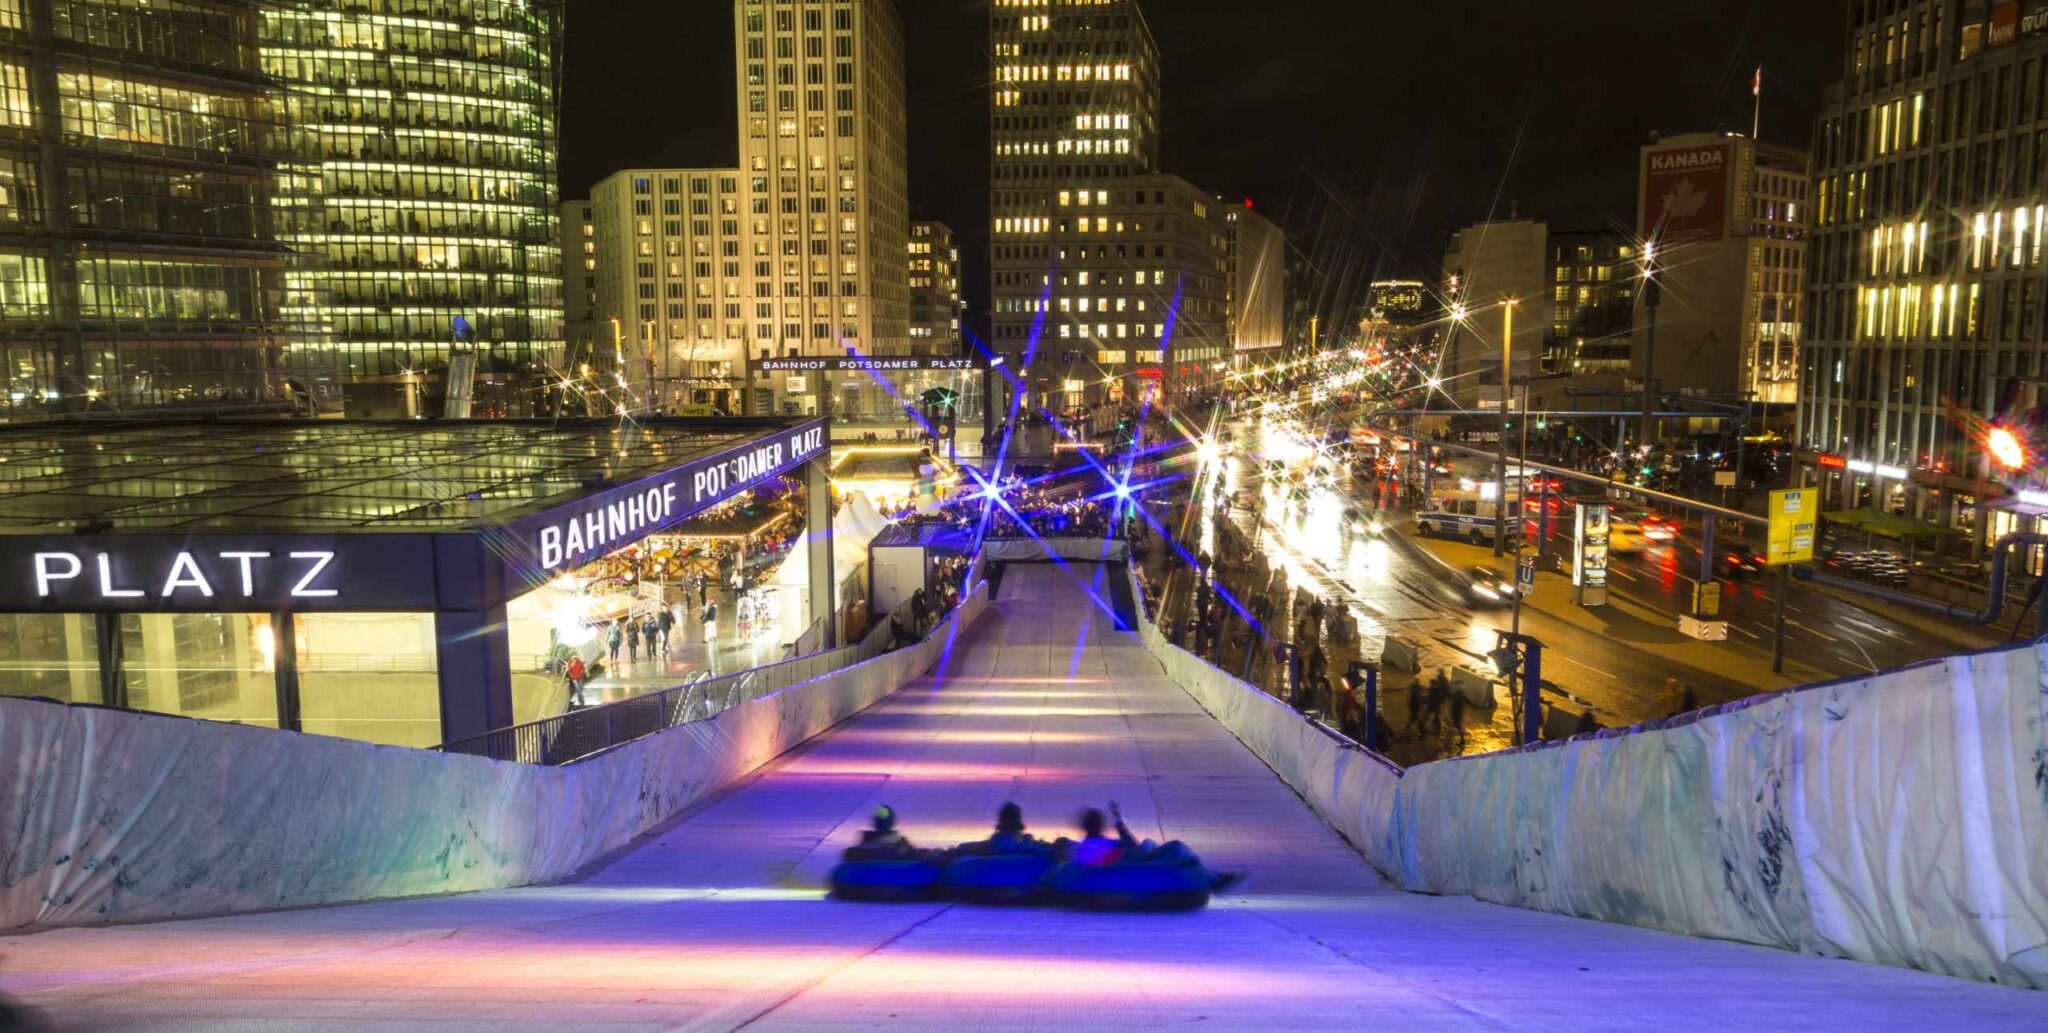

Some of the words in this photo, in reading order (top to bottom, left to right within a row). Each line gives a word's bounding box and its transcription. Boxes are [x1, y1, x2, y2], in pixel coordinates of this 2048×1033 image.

[1652, 150, 1723, 169] KANADA
[763, 361, 827, 369] BAHNHOF
[839, 361, 919, 369] POTSDAMER
[932, 360, 973, 368] PLATZ
[540, 482, 676, 569] BAHNHOF
[694, 444, 782, 502] POTSDAMER
[791, 427, 822, 458] PLATZ
[34, 552, 338, 597] PLATZ
[1522, 567, 1532, 582] U
